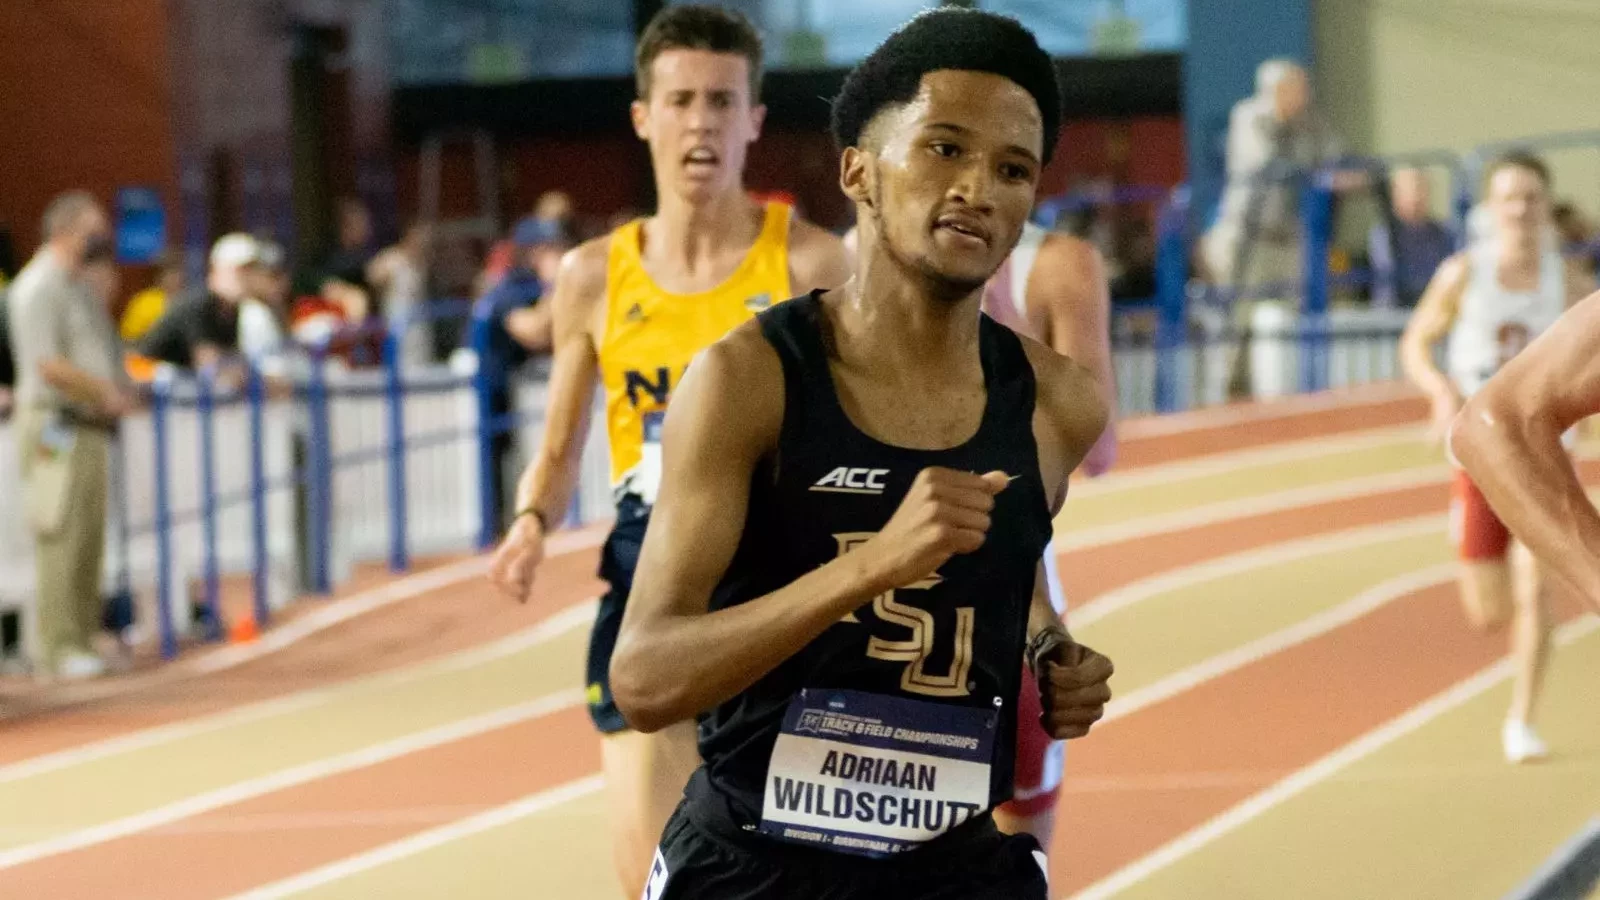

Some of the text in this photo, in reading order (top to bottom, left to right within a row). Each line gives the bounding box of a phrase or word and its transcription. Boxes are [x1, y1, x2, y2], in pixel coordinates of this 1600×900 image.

[816, 466, 891, 489] ACC
[821, 715, 857, 734] TRACK
[863, 723, 893, 739] FIELD
[892, 727, 980, 750] CHAMPIONSHIPS
[819, 749, 937, 792] ADRIAAN
